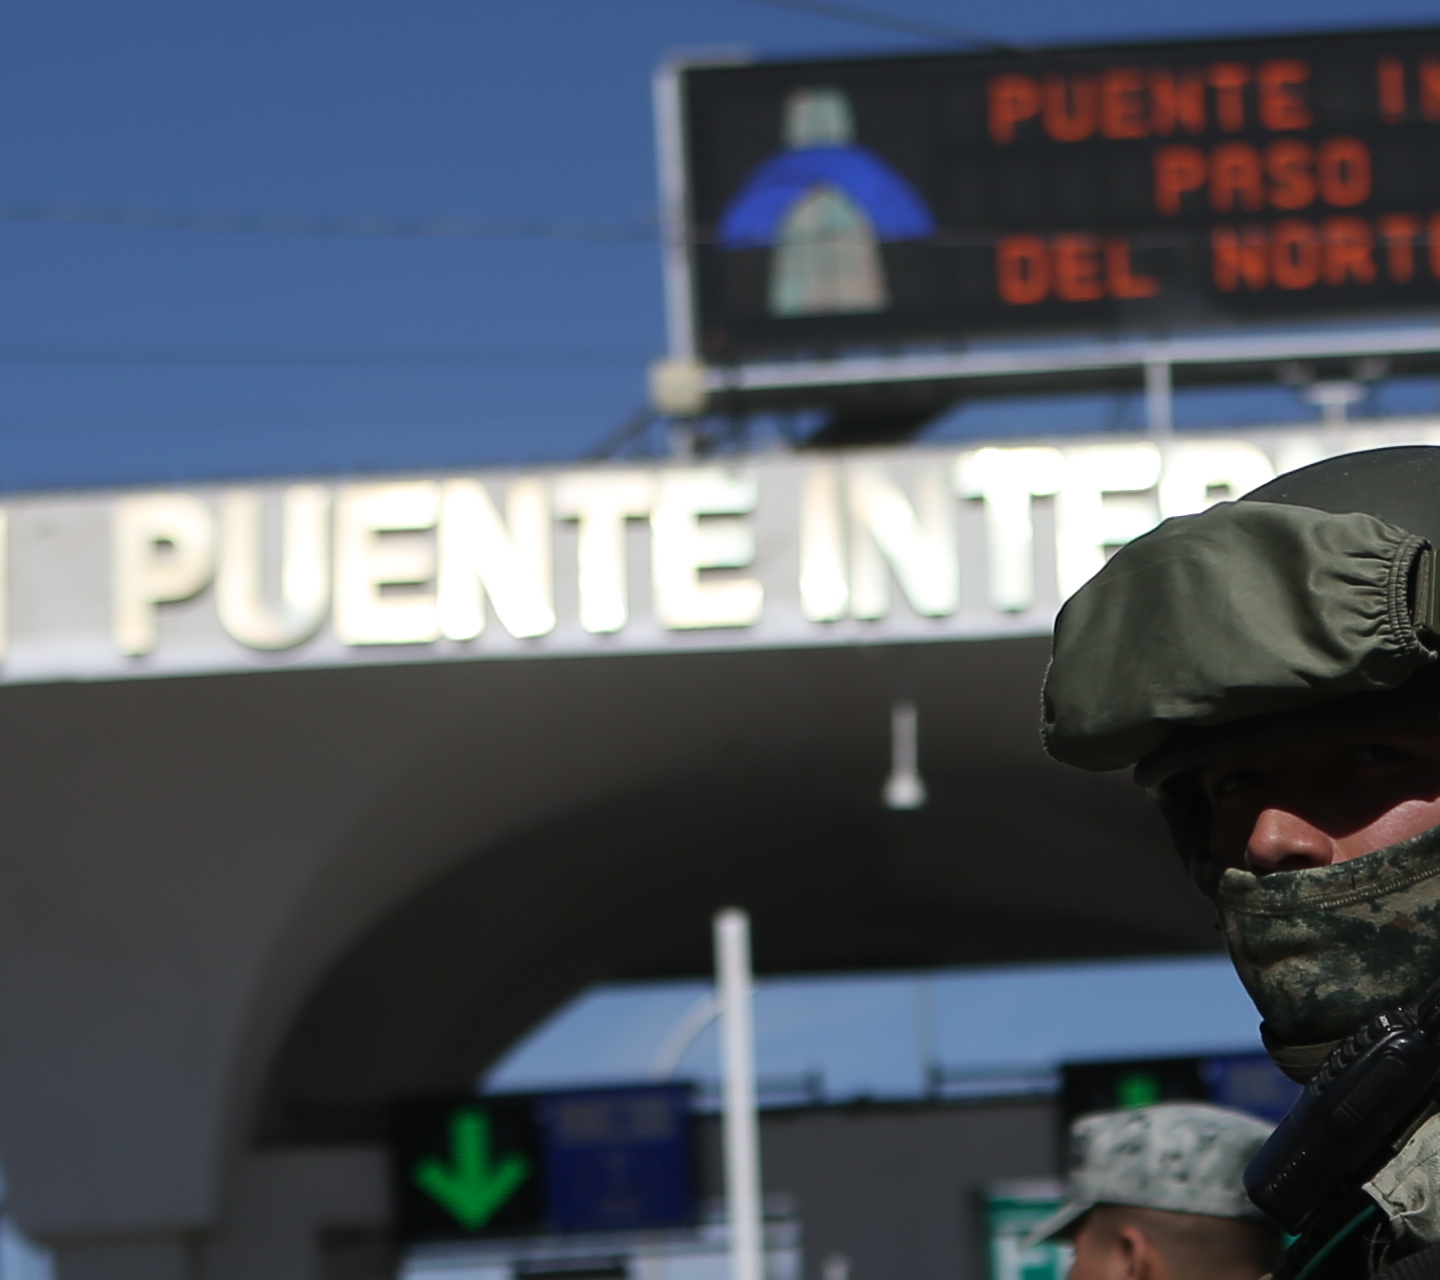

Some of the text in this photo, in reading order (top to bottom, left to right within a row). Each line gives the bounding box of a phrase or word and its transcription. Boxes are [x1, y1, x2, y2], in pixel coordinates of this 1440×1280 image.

[987, 61, 1313, 144] PUENTE
[1156, 138, 1372, 211] PASO
[997, 231, 1160, 305] DEL
[112, 478, 764, 656] PUENTE
